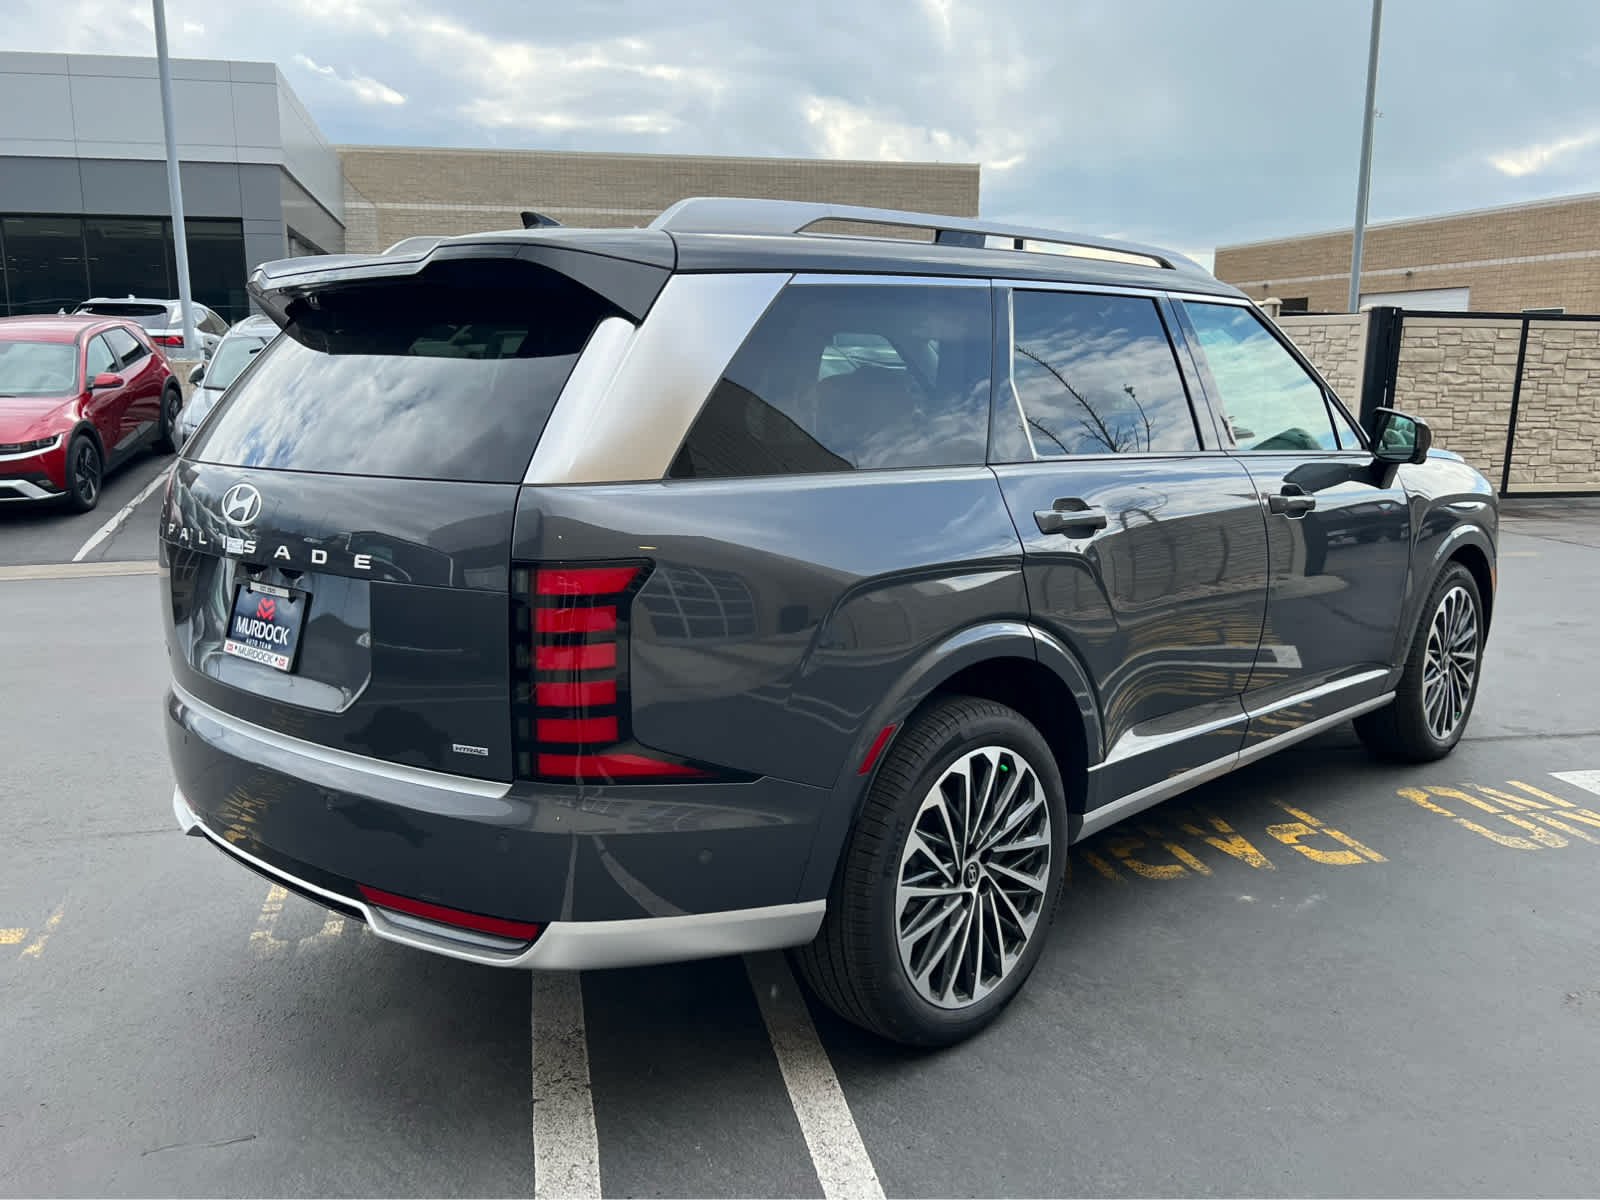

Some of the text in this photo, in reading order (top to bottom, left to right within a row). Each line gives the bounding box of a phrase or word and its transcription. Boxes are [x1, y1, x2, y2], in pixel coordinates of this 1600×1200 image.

[168, 523, 373, 570] PALISADE
[235, 616, 290, 646] MURDOCK
[238, 646, 274, 664] MURDOCK
[259, 641, 272, 650] TEAM
